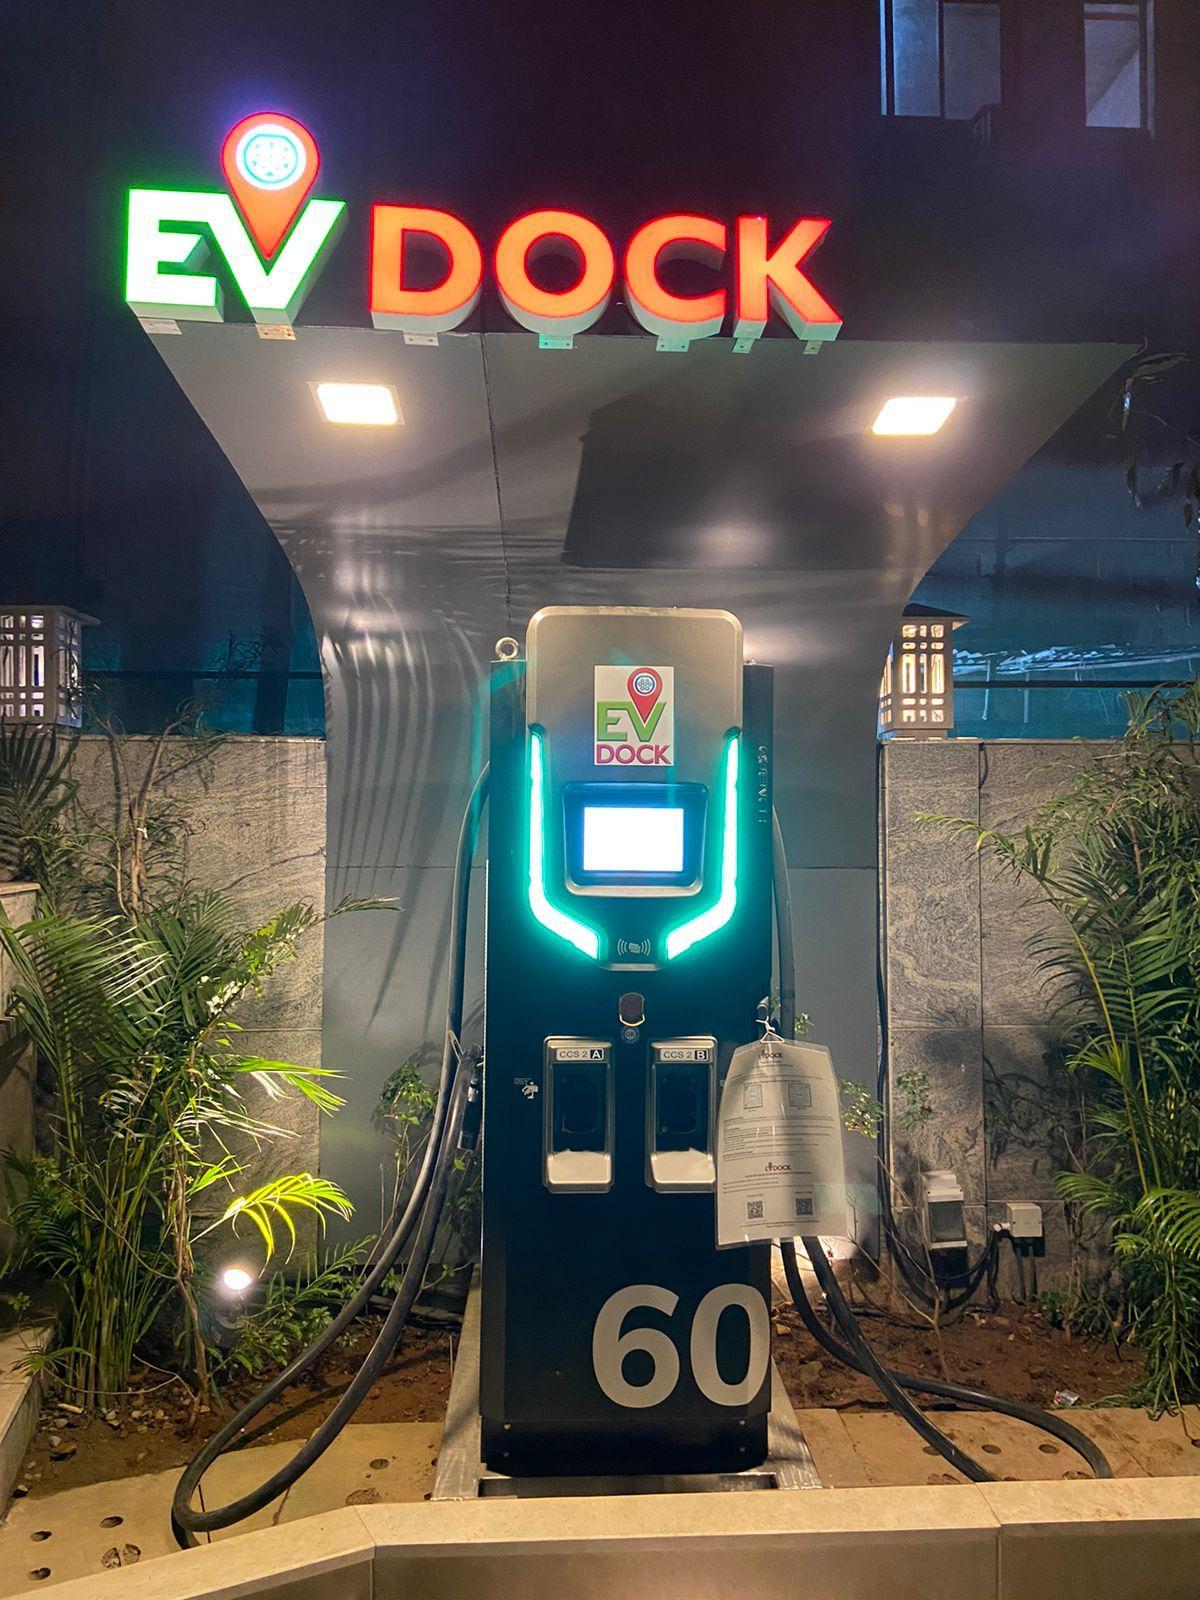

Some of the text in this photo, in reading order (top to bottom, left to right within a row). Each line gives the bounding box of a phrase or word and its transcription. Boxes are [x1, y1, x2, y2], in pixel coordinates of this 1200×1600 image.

[126, 186, 843, 334] EV DOCK
[597, 701, 667, 742] EV
[596, 744, 671, 764] DOCK
[591, 1050, 602, 1059] A
[697, 1050, 707, 1059] B
[592, 1283, 770, 1409] 60
